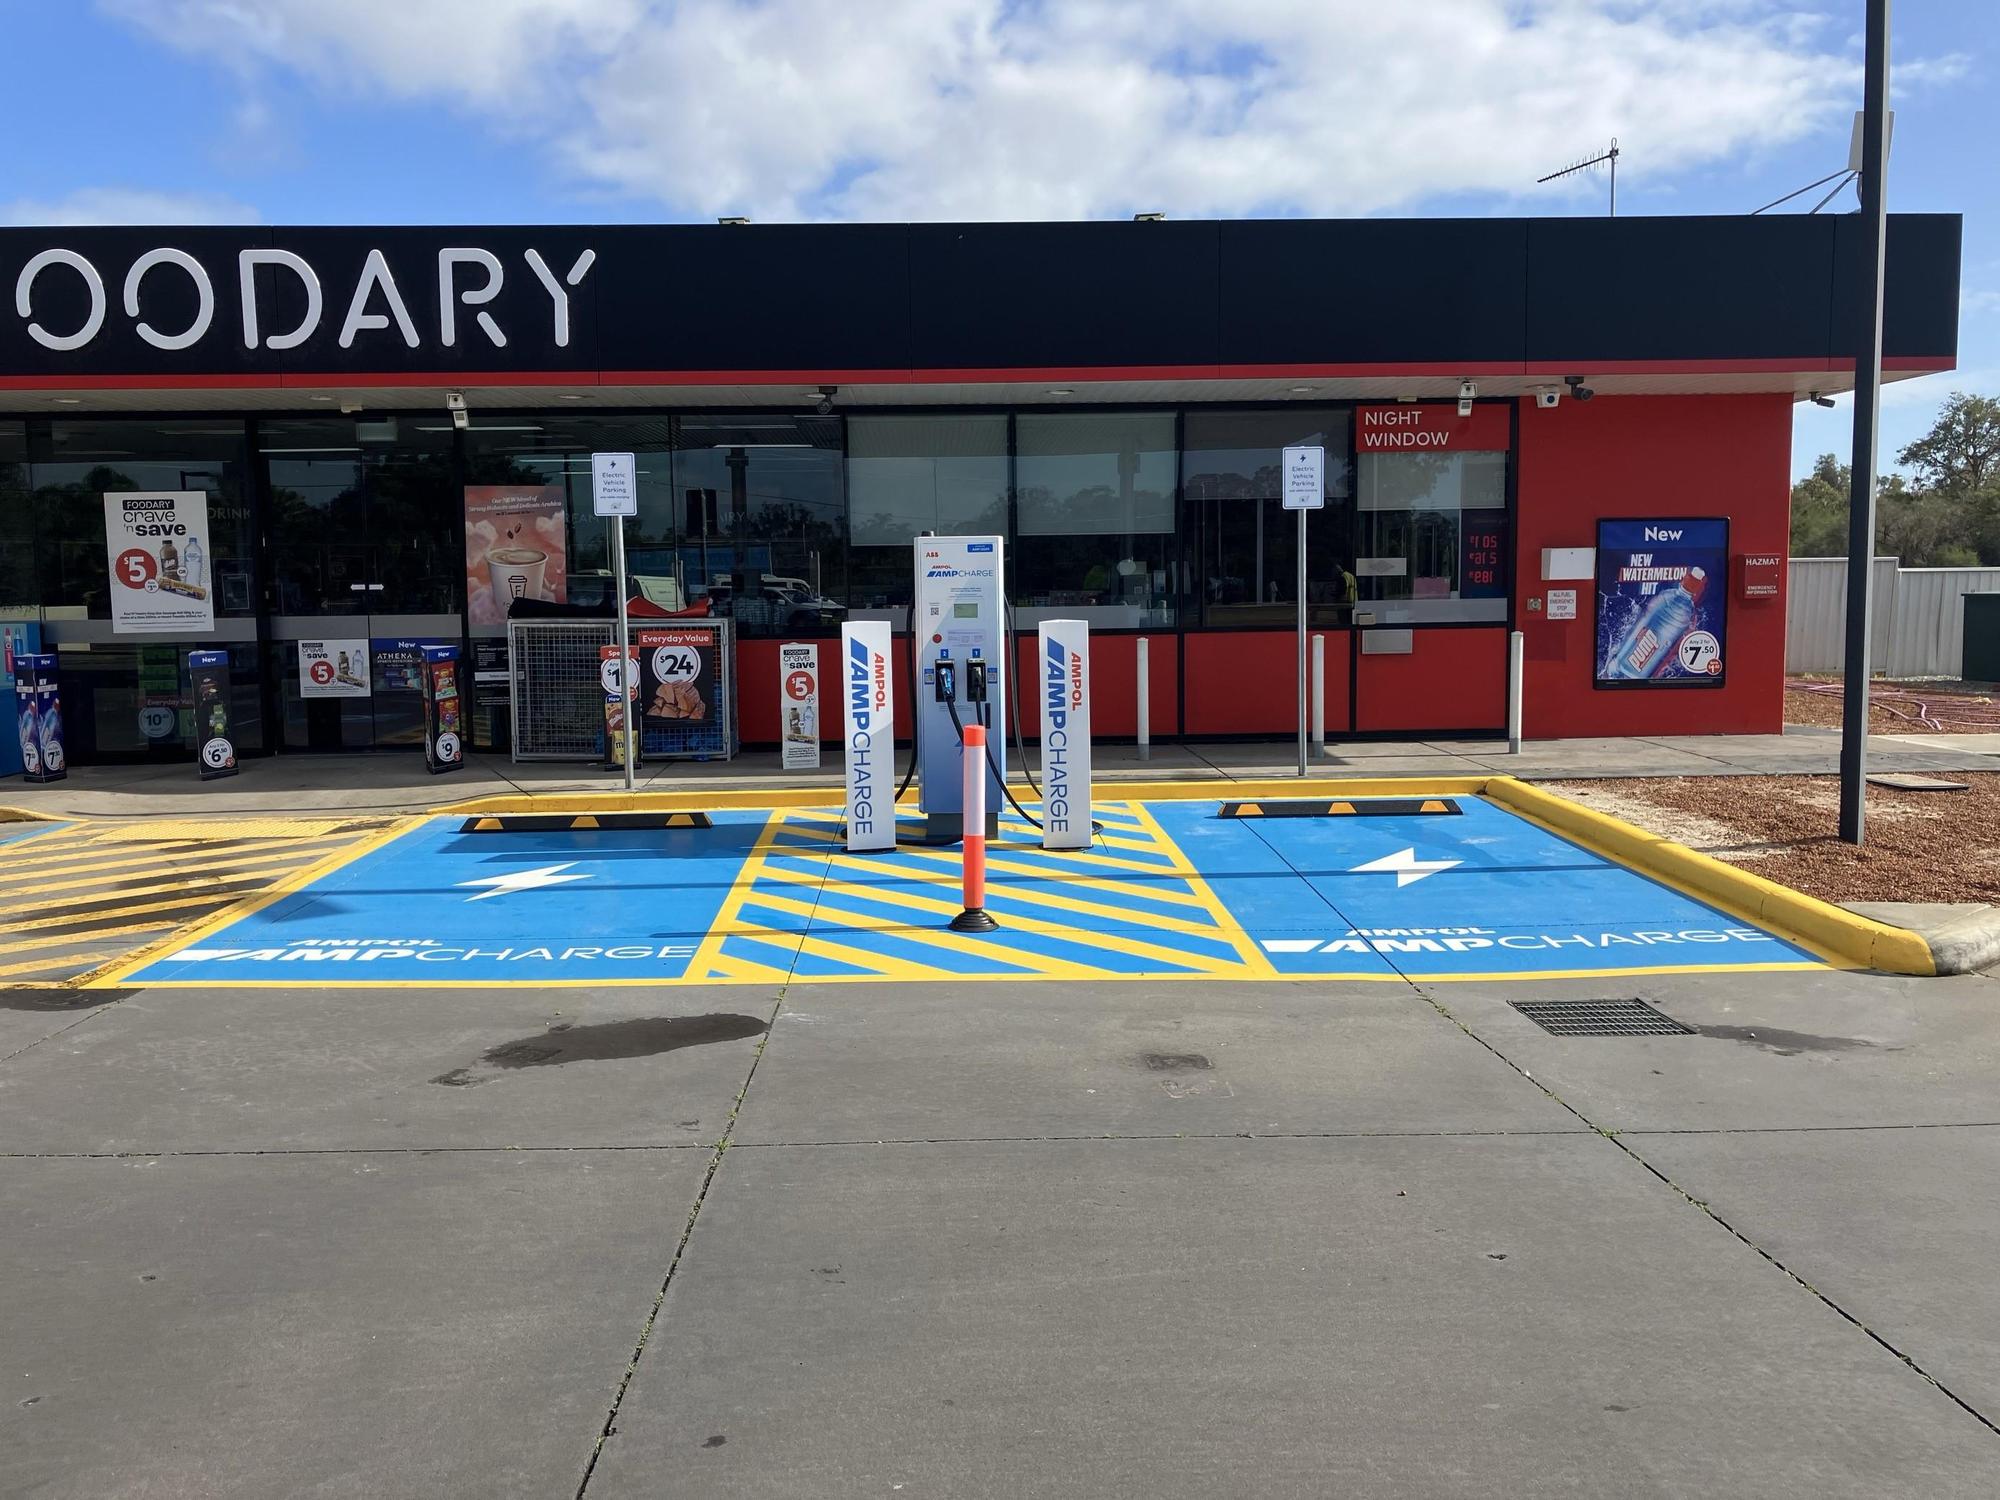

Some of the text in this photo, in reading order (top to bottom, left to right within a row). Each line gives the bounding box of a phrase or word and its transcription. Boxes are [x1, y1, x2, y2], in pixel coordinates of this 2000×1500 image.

[16, 247, 597, 351] OODARY
[1365, 411, 1422, 425] NIGHT
[1364, 432, 1449, 447] WINDOW
[126, 501, 171, 510] FOODARY
[123, 511, 176, 523] crave
[135, 524, 187, 537] save
[1644, 526, 1683, 541] New
[1630, 554, 1653, 567] NEW
[1745, 558, 1780, 566] HAZMAT
[124, 556, 147, 582] $5
[933, 569, 994, 577] AMPCHARGE
[1622, 567, 1688, 581] WATERMELON
[1641, 582, 1659, 595] HIT
[643, 634, 710, 643] Everyday Value
[377, 652, 413, 660] ATHENA
[1628, 629, 1659, 672] pump
[1684, 645, 1715, 665] $7.50
[660, 654, 695, 675] $24
[789, 661, 816, 669] save
[874, 652, 886, 712] AMPOL
[1071, 652, 1082, 711] AMPOL
[850, 661, 873, 835] AMPCHARGE
[1047, 661, 1069, 833] AMPCHARGE
[1345, 927, 1497, 937] AMPOL
[286, 938, 446, 946] AMPOL
[1318, 929, 1776, 953] AMPCHARGE
[216, 945, 698, 961] AMPCHARGE
